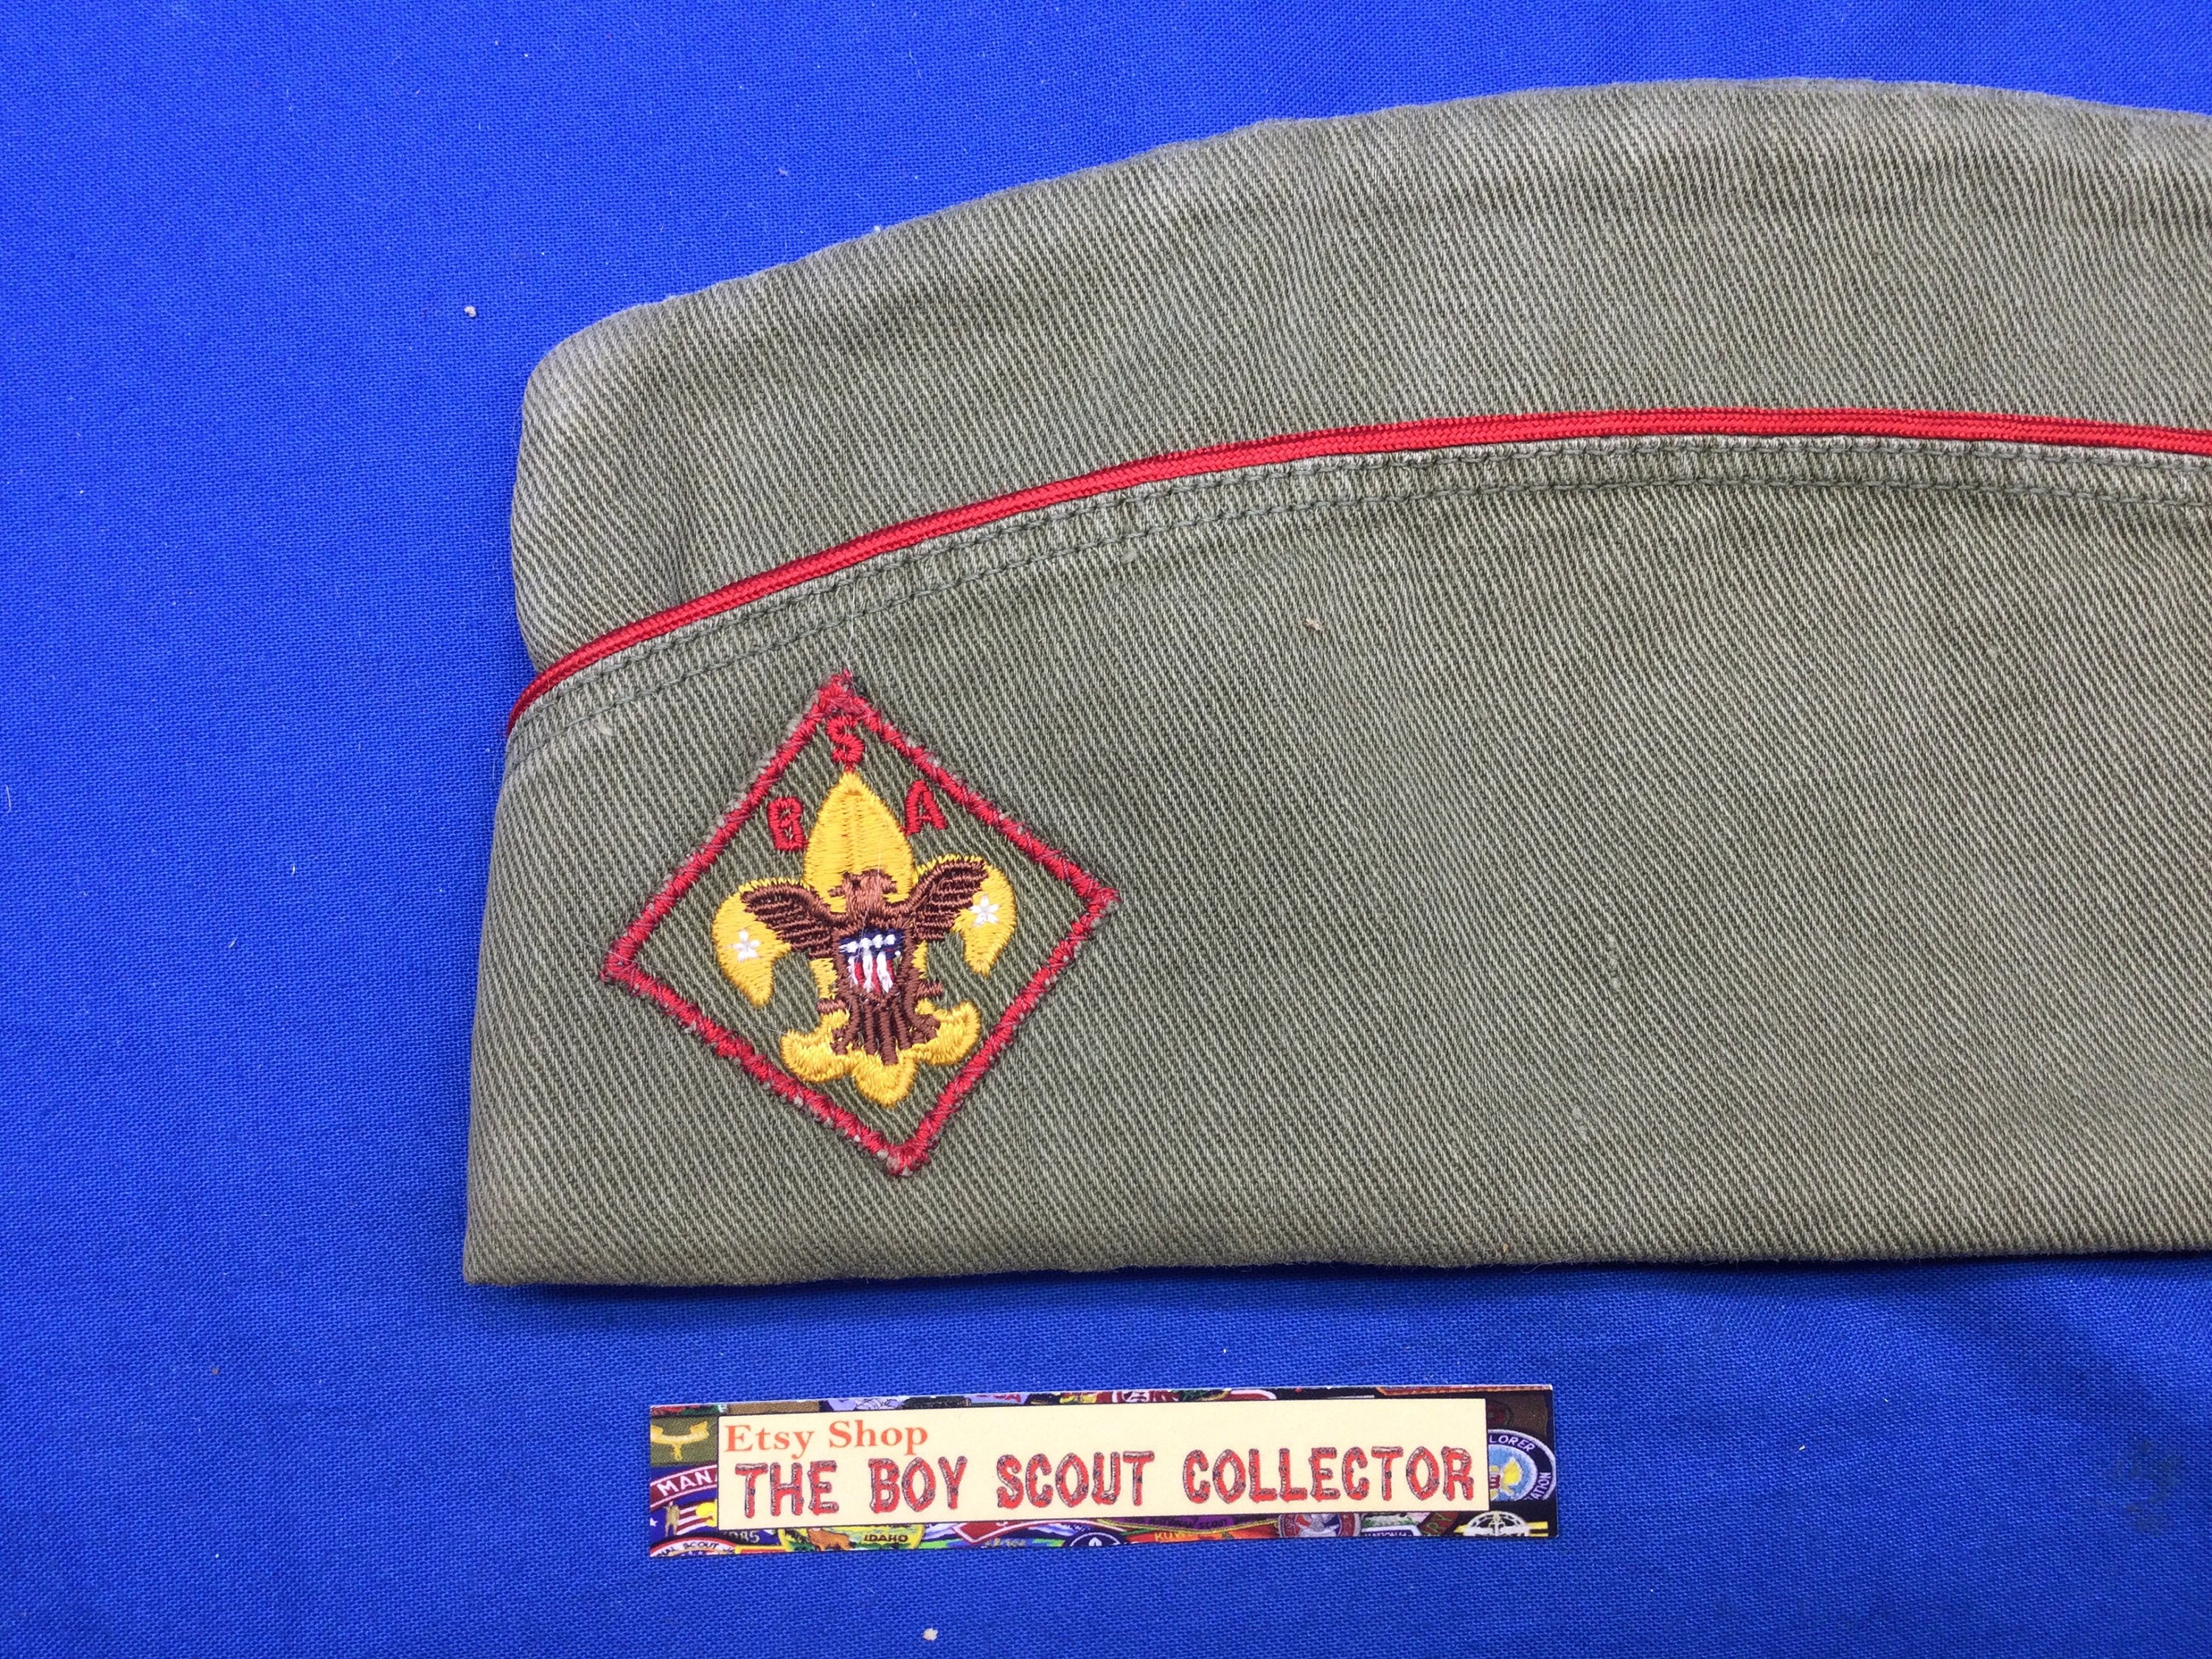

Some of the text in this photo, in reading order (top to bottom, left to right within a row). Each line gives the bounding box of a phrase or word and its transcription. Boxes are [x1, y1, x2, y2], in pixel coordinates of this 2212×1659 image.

[723, 1419, 928, 1459] Etsy Shop
[656, 1469, 717, 1497] MAN
[734, 1446, 1474, 1519] THE BOY SCOUT COLLECTOR
[683, 1541, 719, 1549] SCOUT
[863, 1534, 908, 1543] IDAHO
